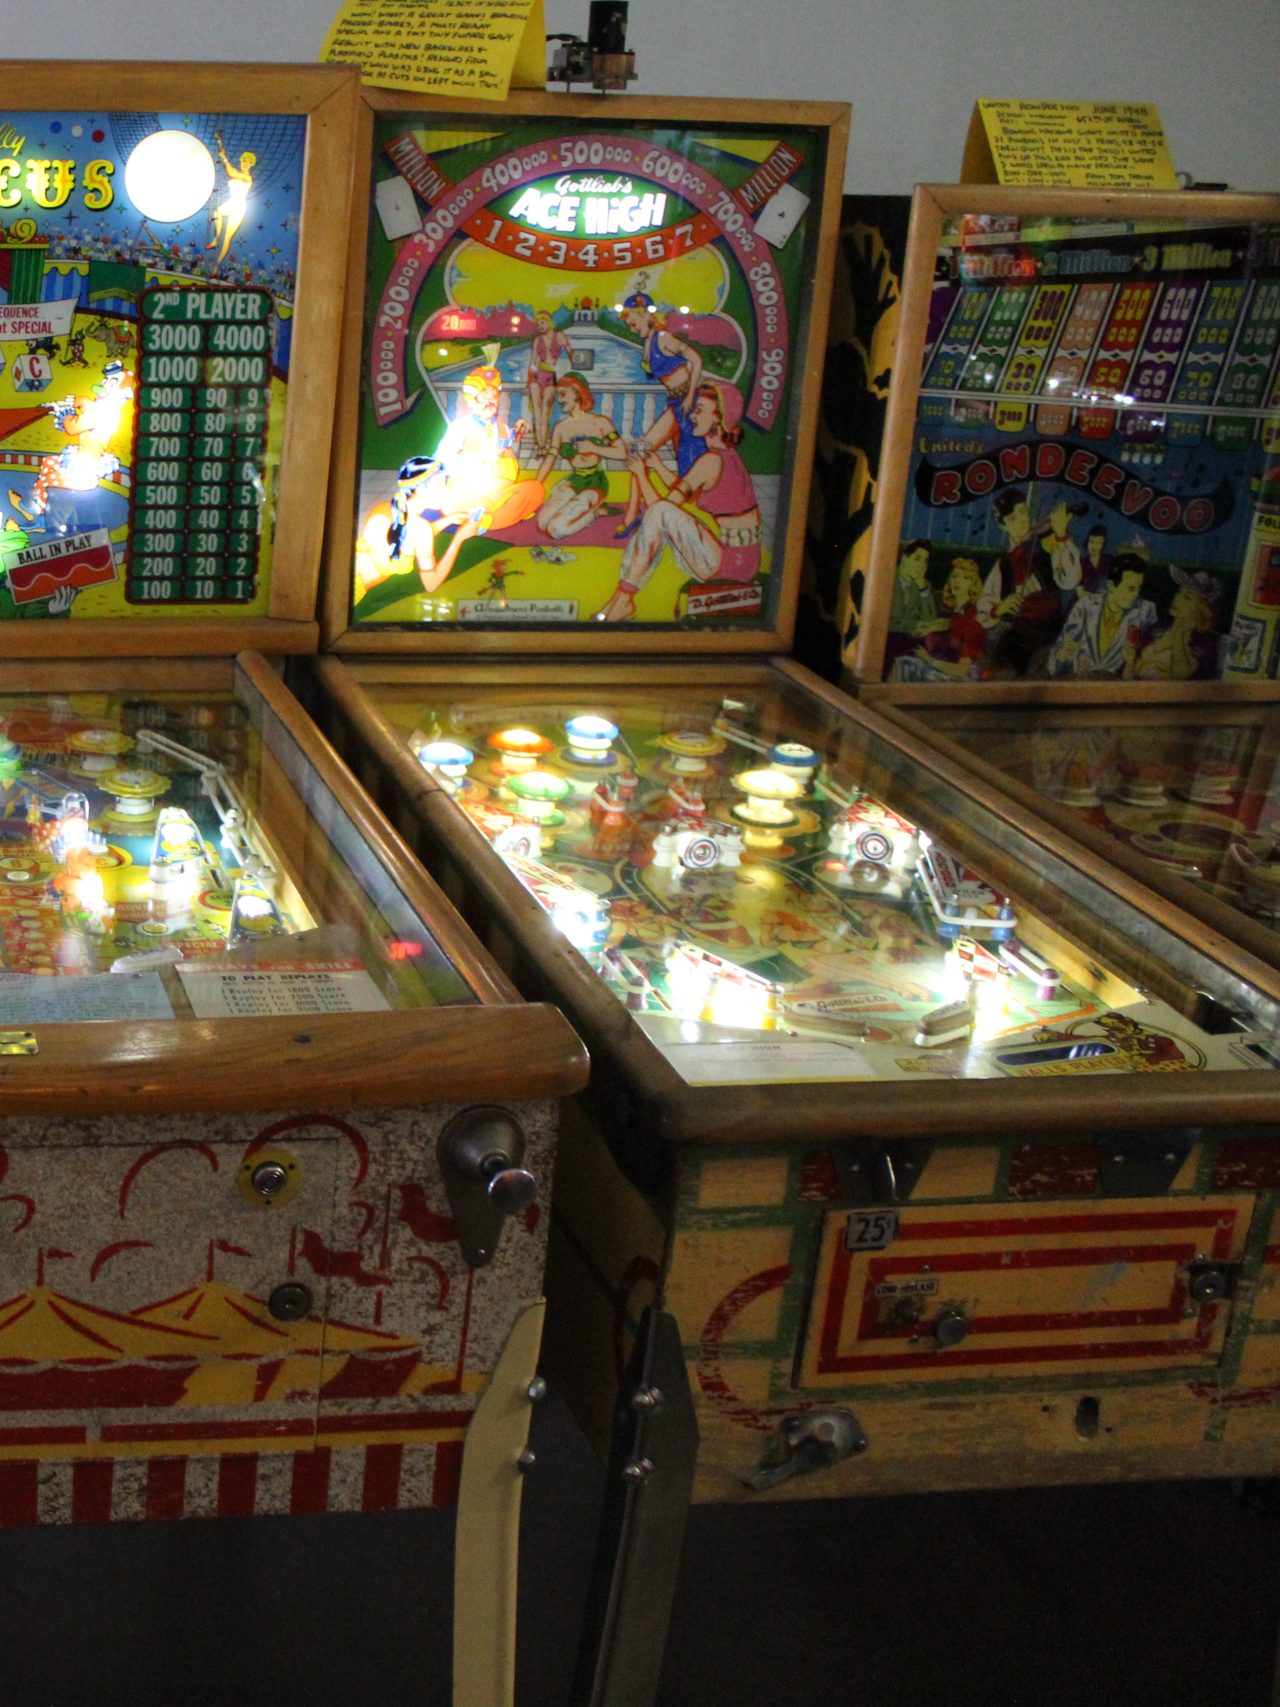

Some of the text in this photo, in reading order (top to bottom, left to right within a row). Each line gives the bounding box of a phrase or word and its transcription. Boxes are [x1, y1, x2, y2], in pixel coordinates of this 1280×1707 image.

[391, 136, 447, 199] MILLION
[739, 147, 797, 208] MILLION
[554, 174, 633, 195] Gottlieb's
[508, 187, 581, 233] ACE
[152, 292, 262, 319] 2ND PLAYER
[11, 321, 54, 334] SPECIAL
[148, 324, 265, 350] 3000 4000
[29, 357, 42, 378] C
[148, 356, 264, 383] 1000 2000
[150, 388, 259, 408] 900 90 9
[149, 413, 256, 433] 800 80 8
[149, 437, 255, 457] 700 70 7
[147, 462, 223, 481] 600 60
[146, 486, 251, 505] 500 50 5
[931, 443, 1215, 531] RONDEEVOO
[145, 509, 249, 529] 400 40 4
[17, 535, 94, 565] BALL IN PLAY
[144, 533, 248, 552] 300 30 3
[142, 557, 246, 576] 200 20 2
[142, 580, 243, 598] 100 10 1
